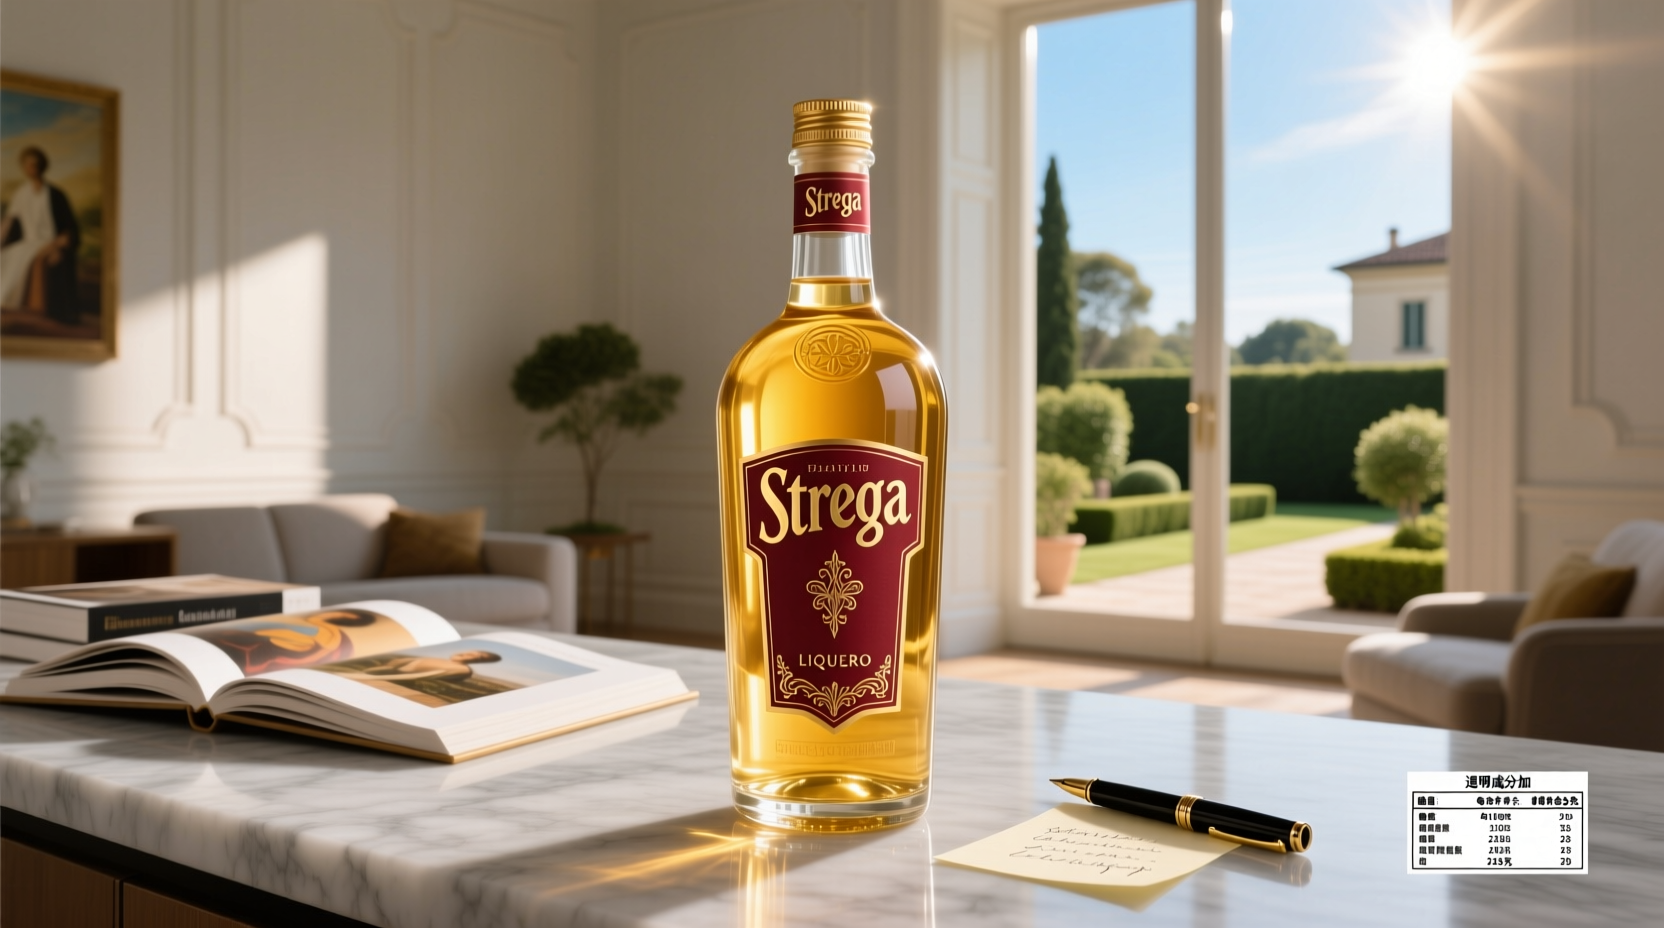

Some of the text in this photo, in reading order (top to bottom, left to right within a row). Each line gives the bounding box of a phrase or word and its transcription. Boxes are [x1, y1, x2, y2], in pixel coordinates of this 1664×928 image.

[805, 186, 862, 218] Strega
[759, 466, 912, 548] Strega
[799, 653, 872, 671] LIQUERO
